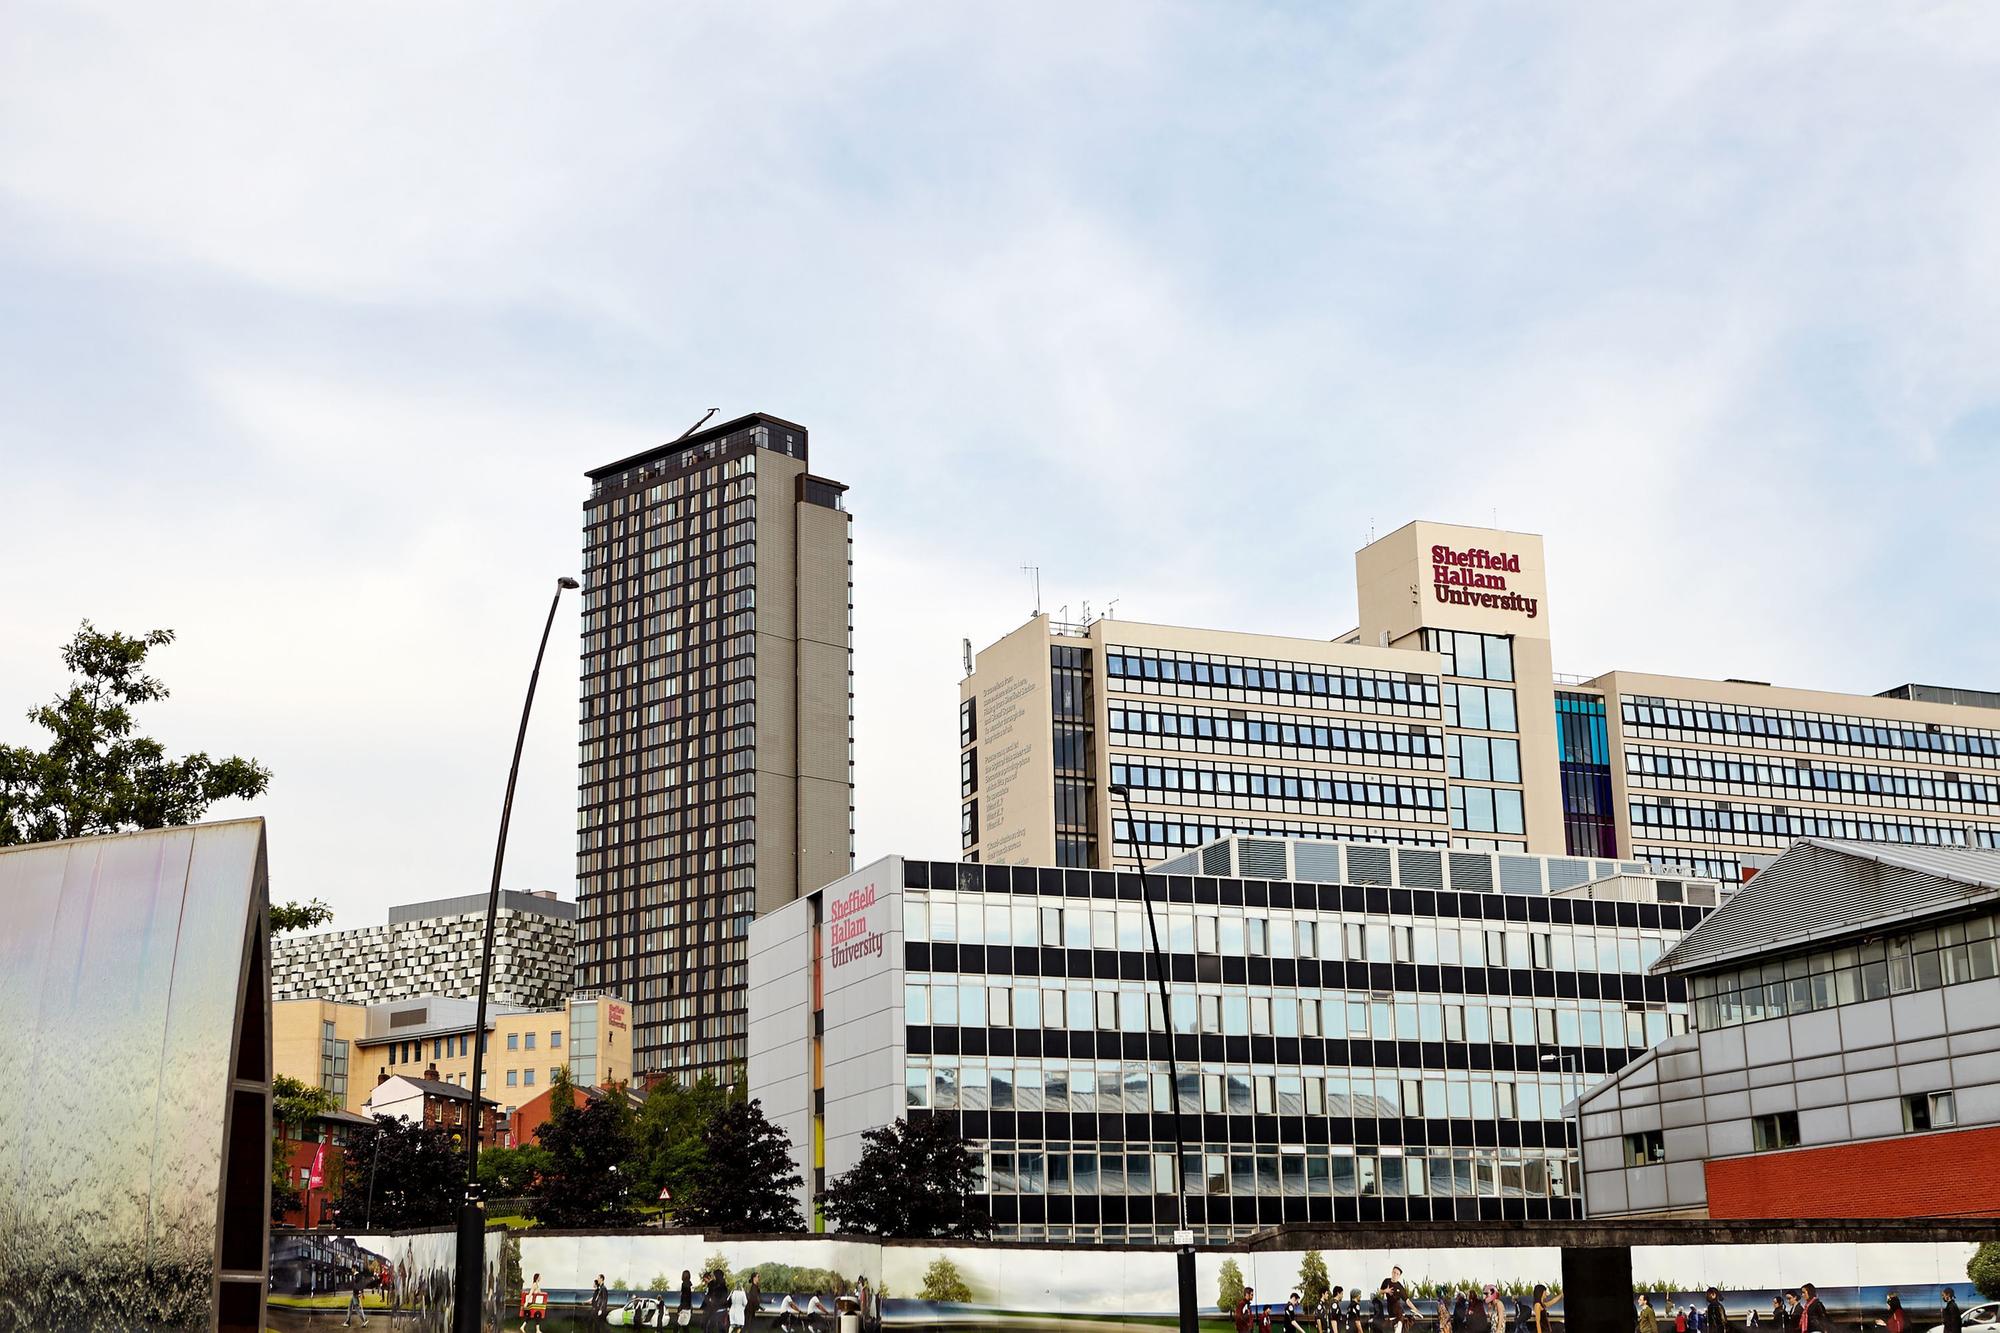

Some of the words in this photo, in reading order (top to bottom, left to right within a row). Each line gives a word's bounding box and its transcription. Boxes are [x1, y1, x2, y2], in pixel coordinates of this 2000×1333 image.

[1431, 545, 1521, 573] Sheffield
[1433, 565, 1507, 591] Hallam
[1434, 584, 1537, 618] University
[831, 884, 875, 922] Sheffield
[831, 916, 866, 946] Hallam
[831, 932, 883, 968] University
